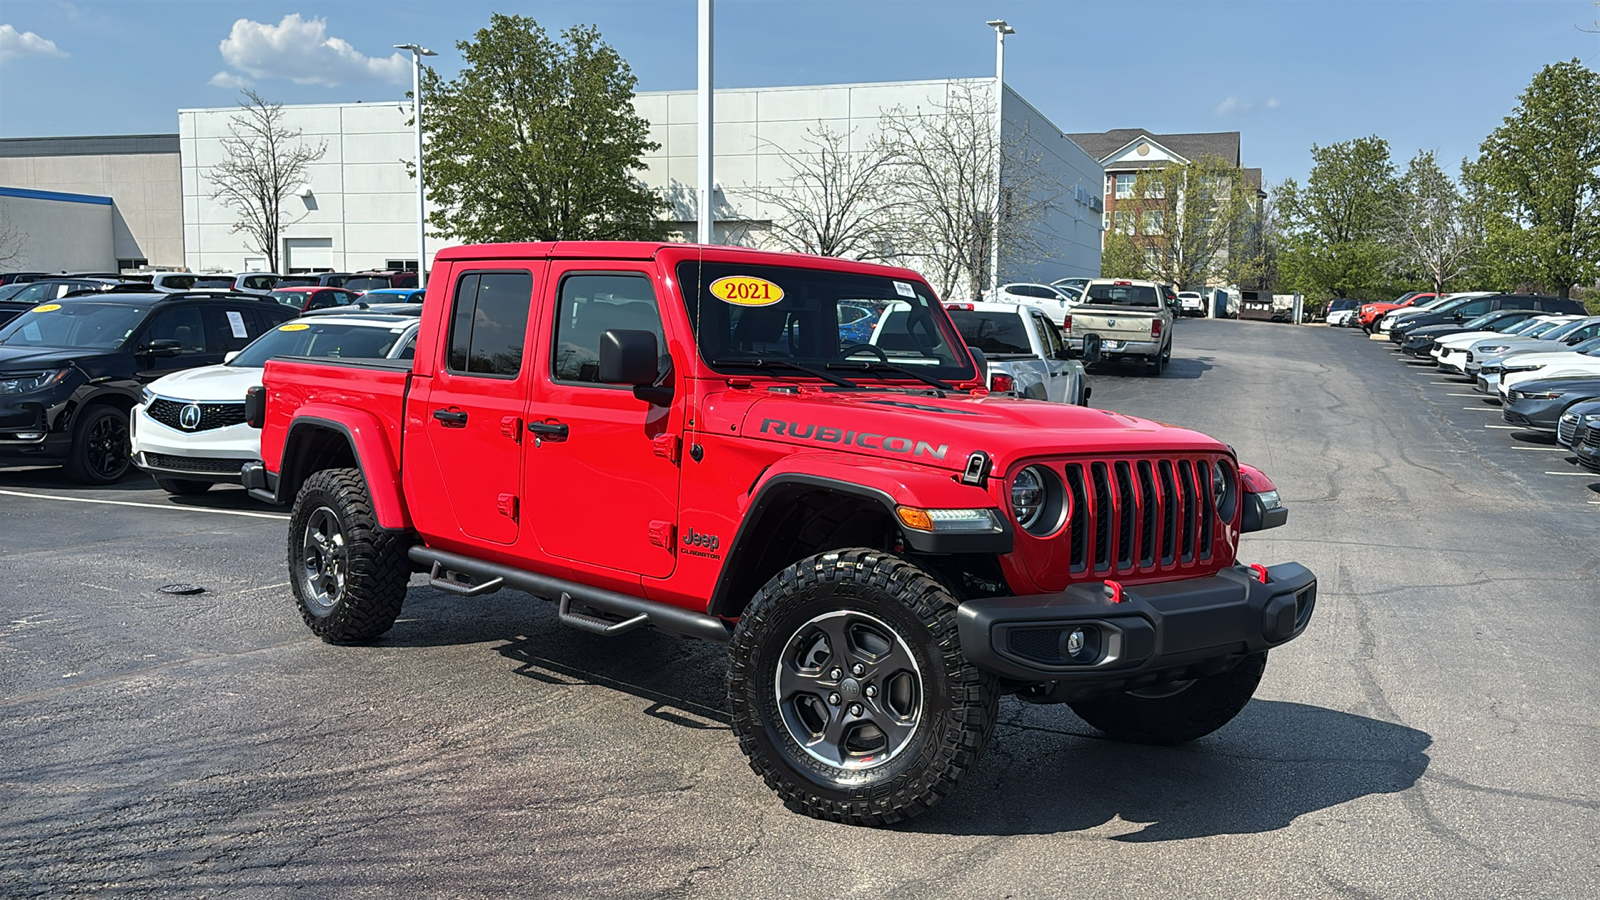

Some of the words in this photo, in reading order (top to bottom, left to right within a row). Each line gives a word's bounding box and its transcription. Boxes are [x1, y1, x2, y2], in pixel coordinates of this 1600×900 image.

[725, 283, 771, 299] 2021
[760, 418, 948, 459] RUBICON
[683, 528, 719, 551] Jeep
[681, 548, 720, 560] GLADIATOR
